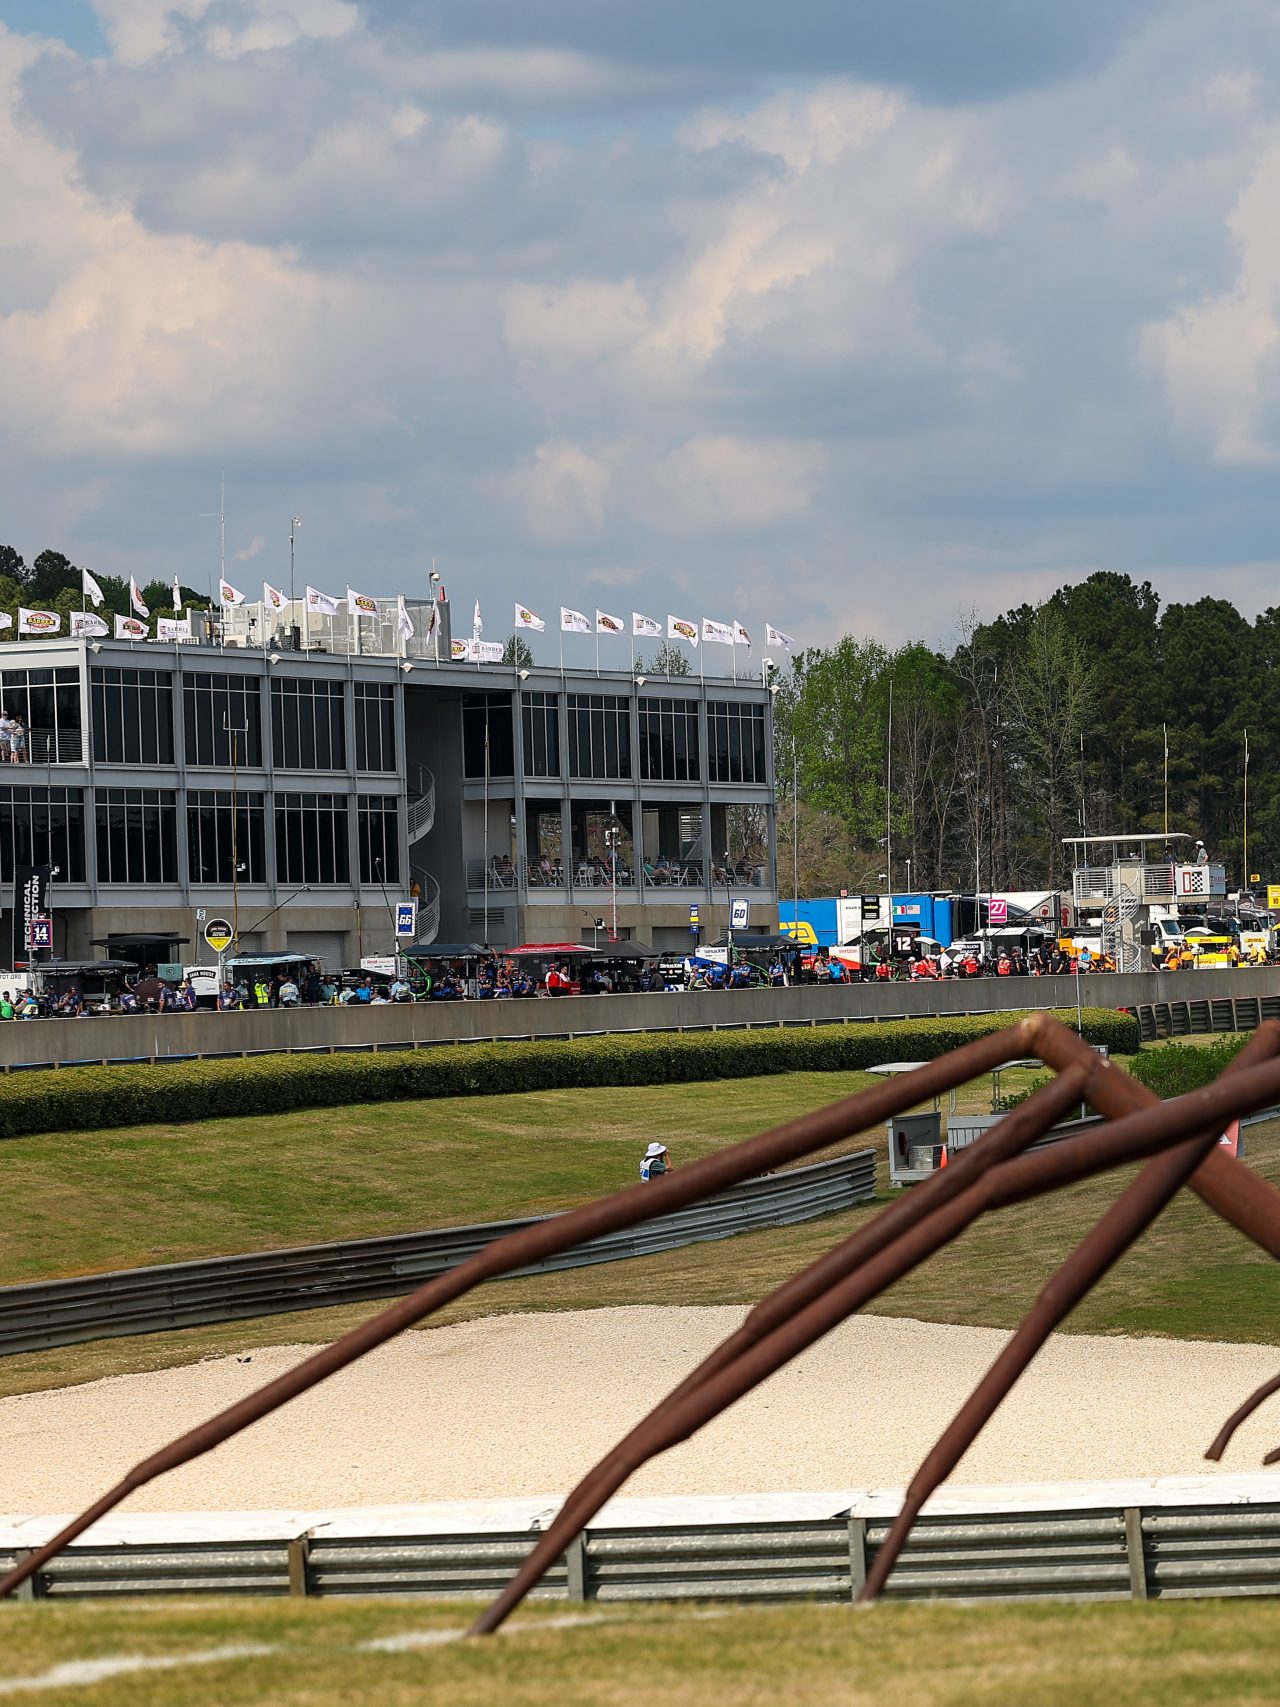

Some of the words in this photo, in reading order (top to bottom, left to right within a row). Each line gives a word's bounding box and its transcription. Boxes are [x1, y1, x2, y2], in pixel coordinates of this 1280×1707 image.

[27, 618, 54, 626] BARBER
[734, 909, 746, 918] 60
[990, 901, 1005, 914] 27
[399, 914, 412, 925] 66
[34, 926, 48, 940] 14
[896, 936, 912, 950] 12
